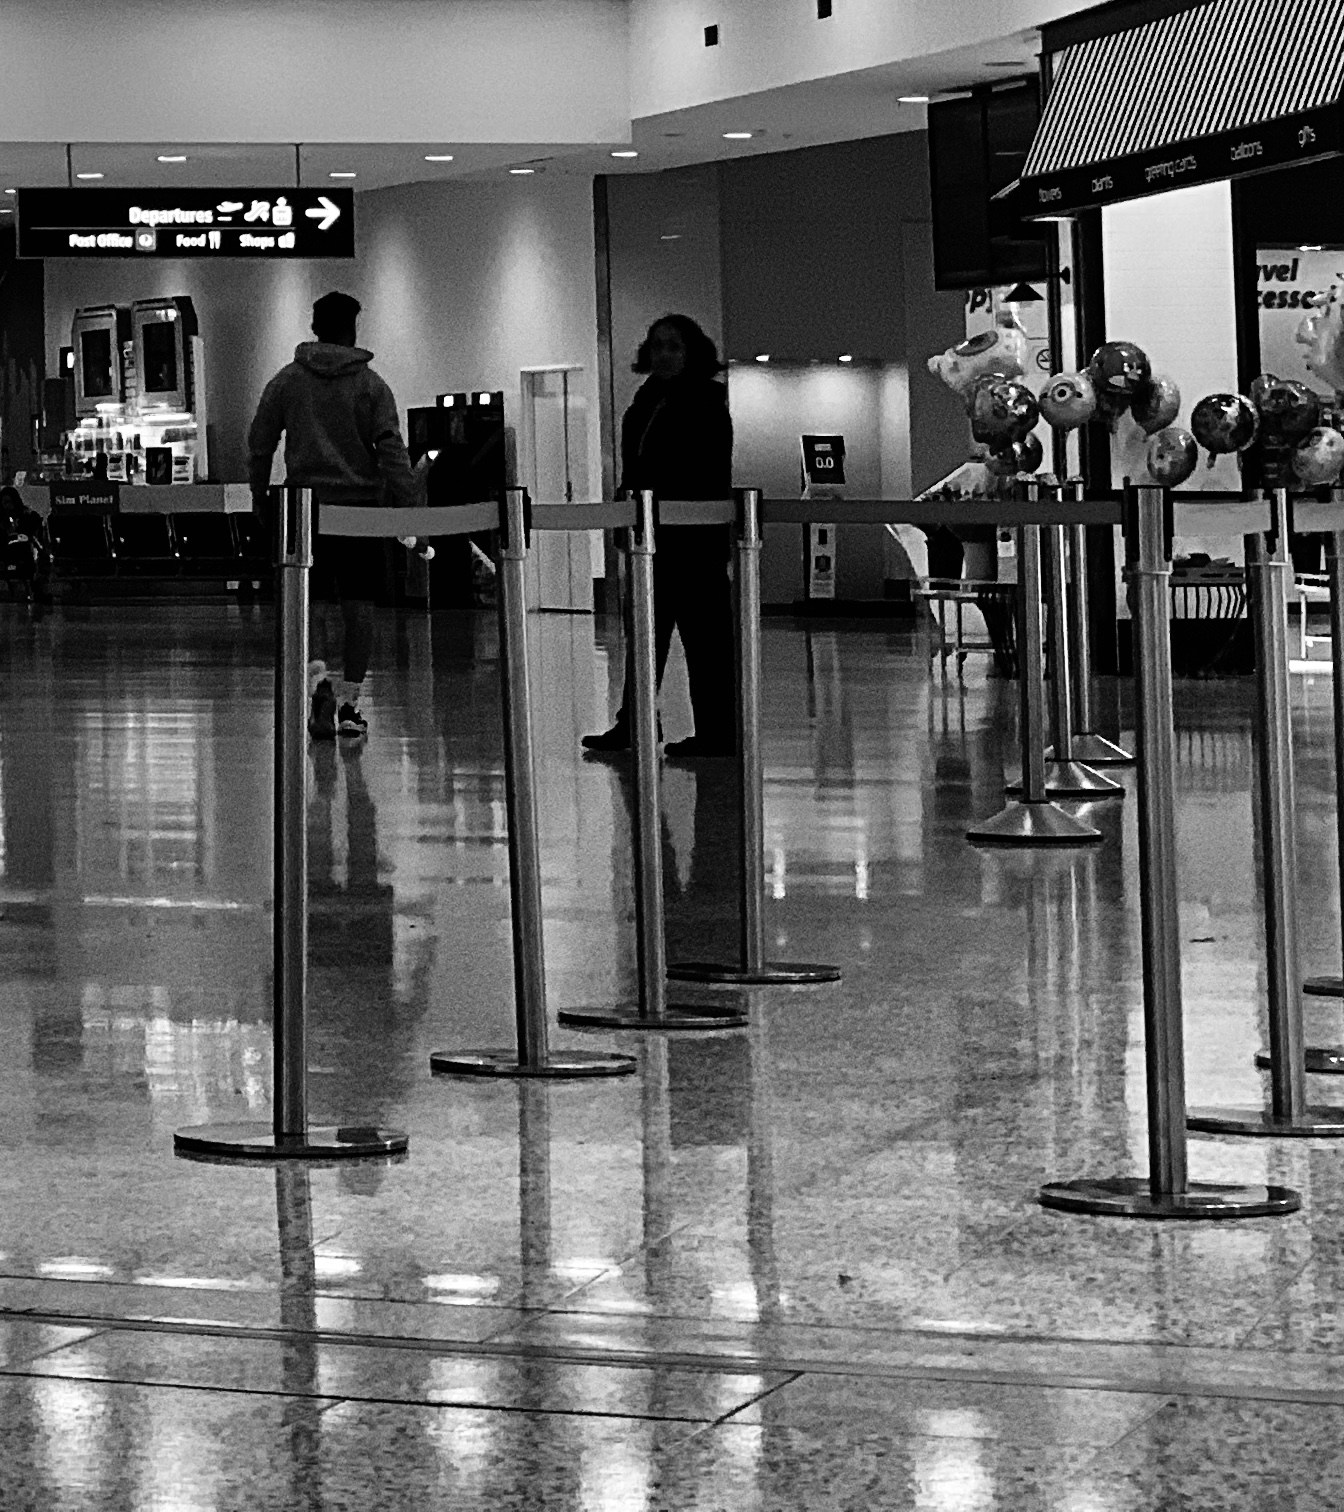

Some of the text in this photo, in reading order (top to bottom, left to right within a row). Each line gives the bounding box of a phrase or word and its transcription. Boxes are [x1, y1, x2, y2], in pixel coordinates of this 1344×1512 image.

[128, 207, 214, 227] Departures
[69, 234, 134, 248] Post Office
[175, 234, 207, 248] Food
[239, 234, 275, 250] Shops
[55, 494, 114, 505] Sim Planet
